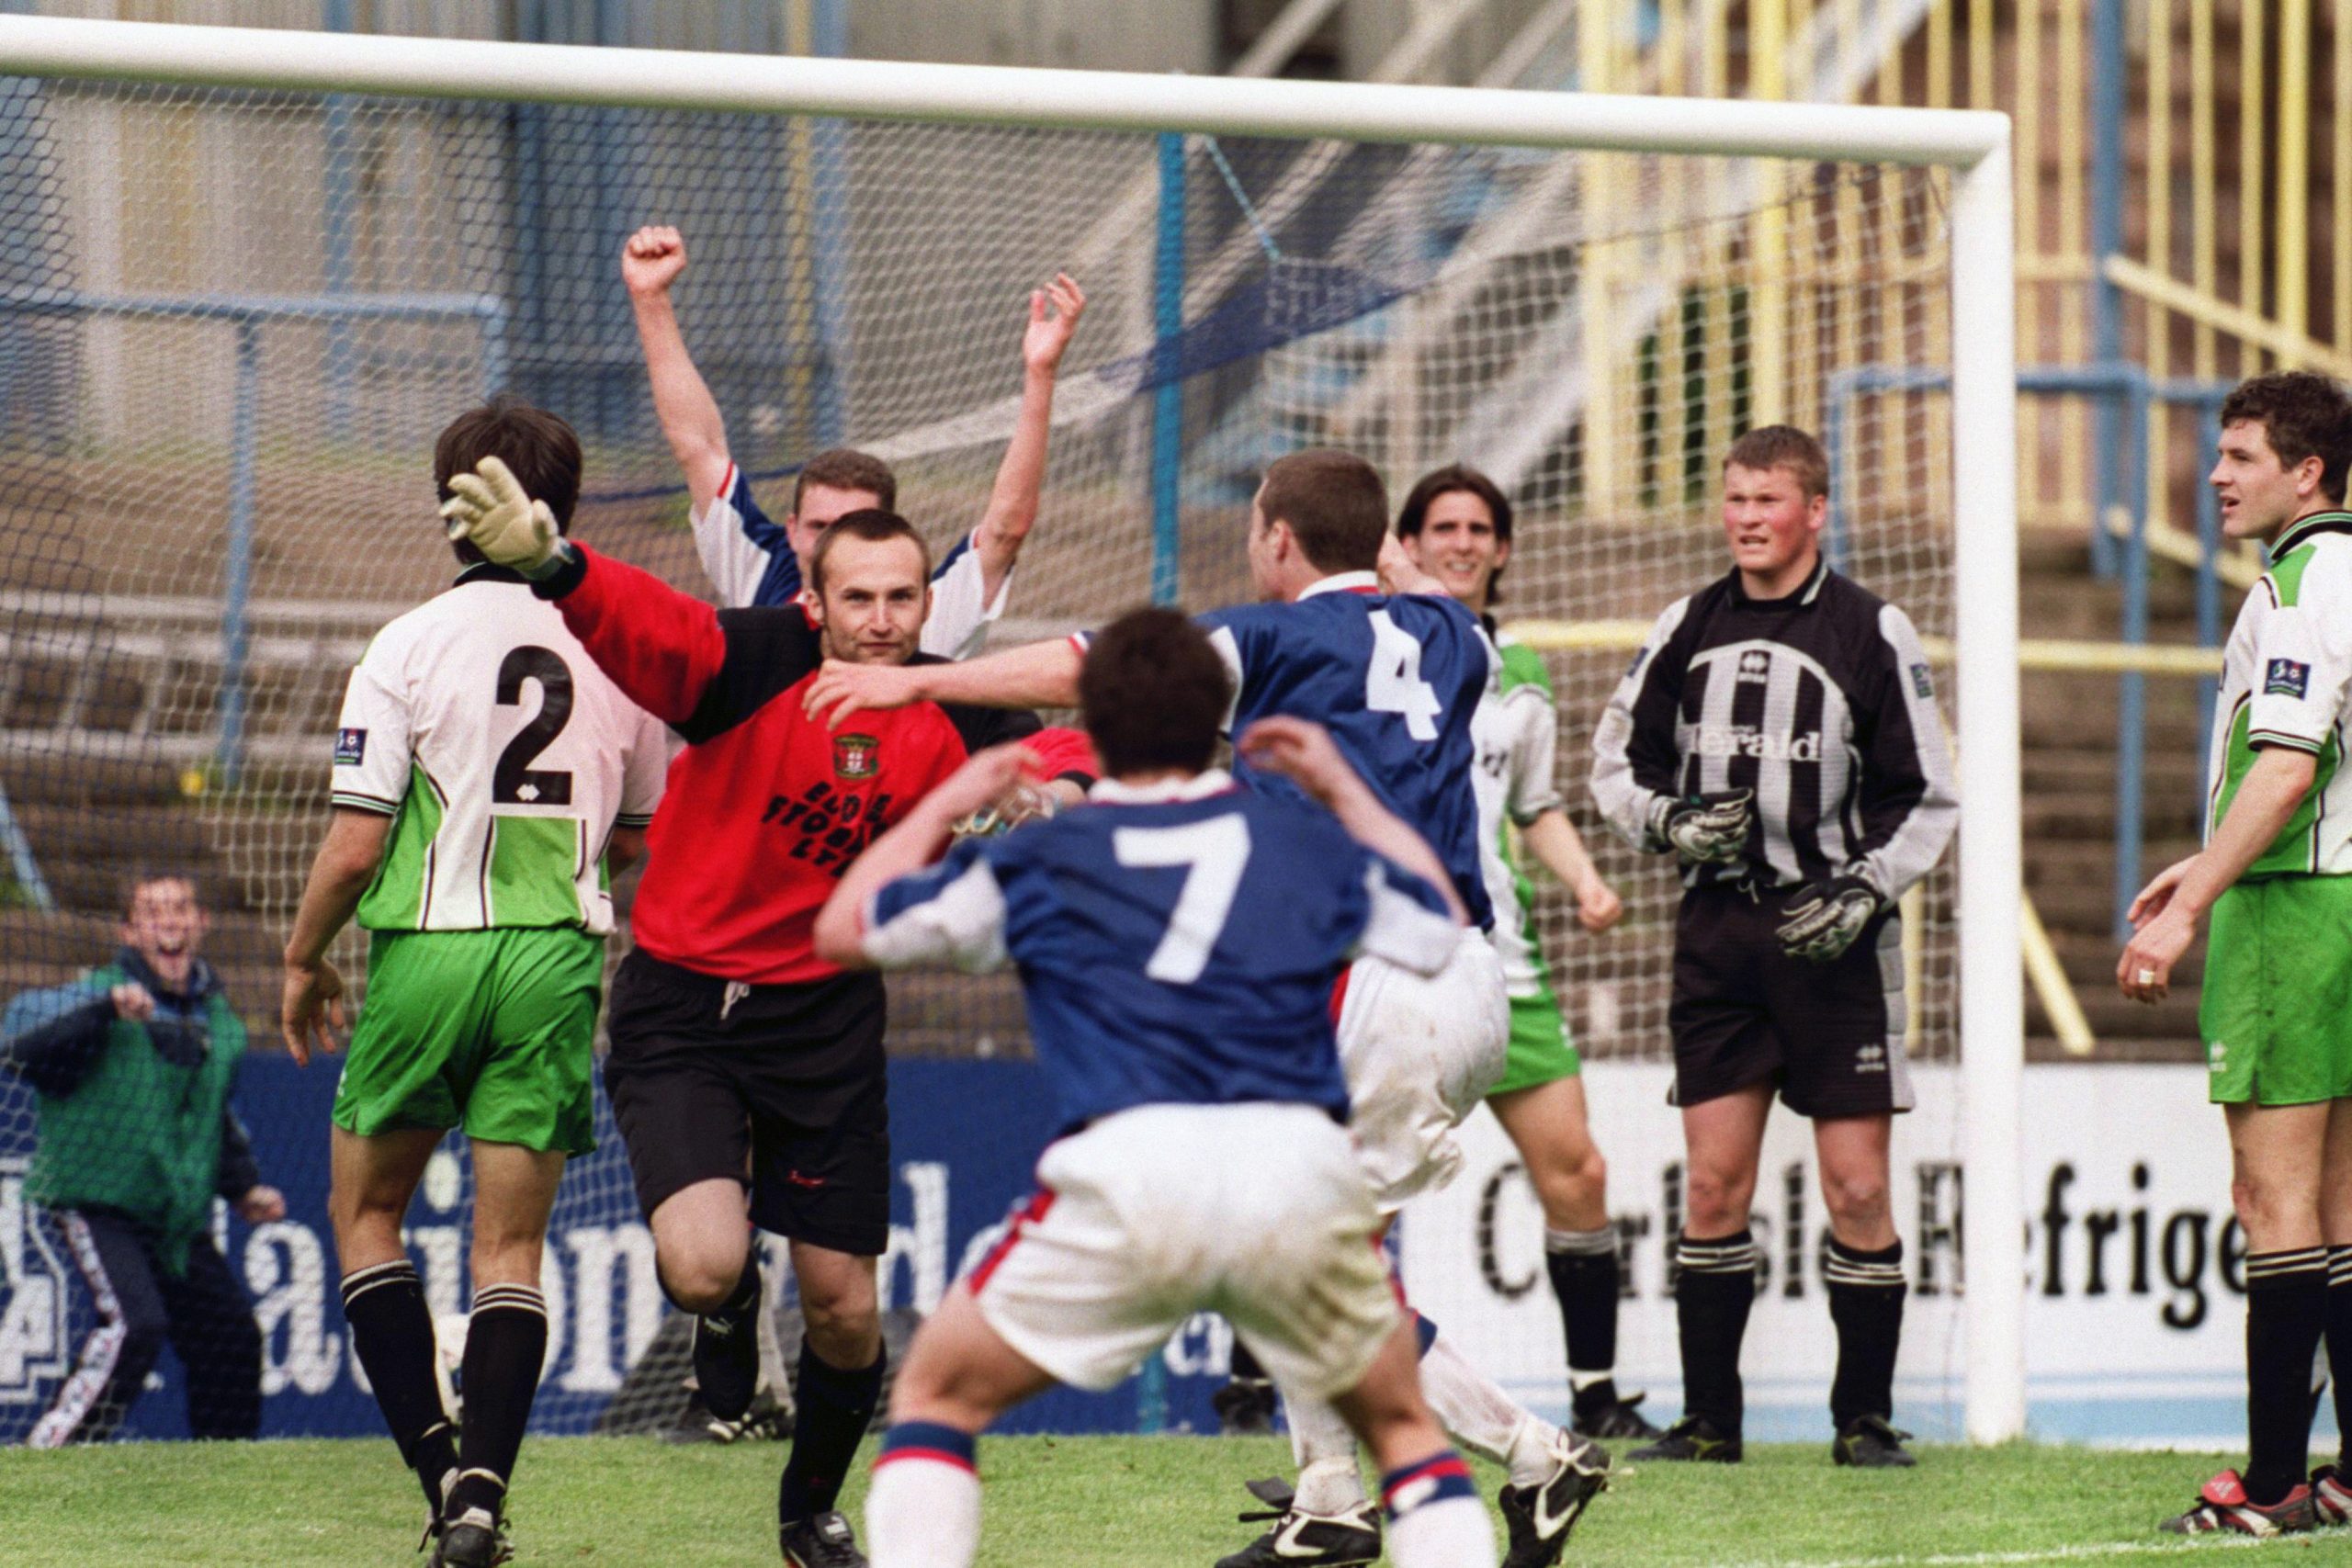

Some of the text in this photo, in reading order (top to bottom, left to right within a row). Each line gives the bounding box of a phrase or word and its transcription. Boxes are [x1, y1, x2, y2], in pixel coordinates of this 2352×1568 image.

[492, 645, 574, 805] 2
[1366, 609, 1442, 740] 4
[1113, 813, 1252, 985] 7
